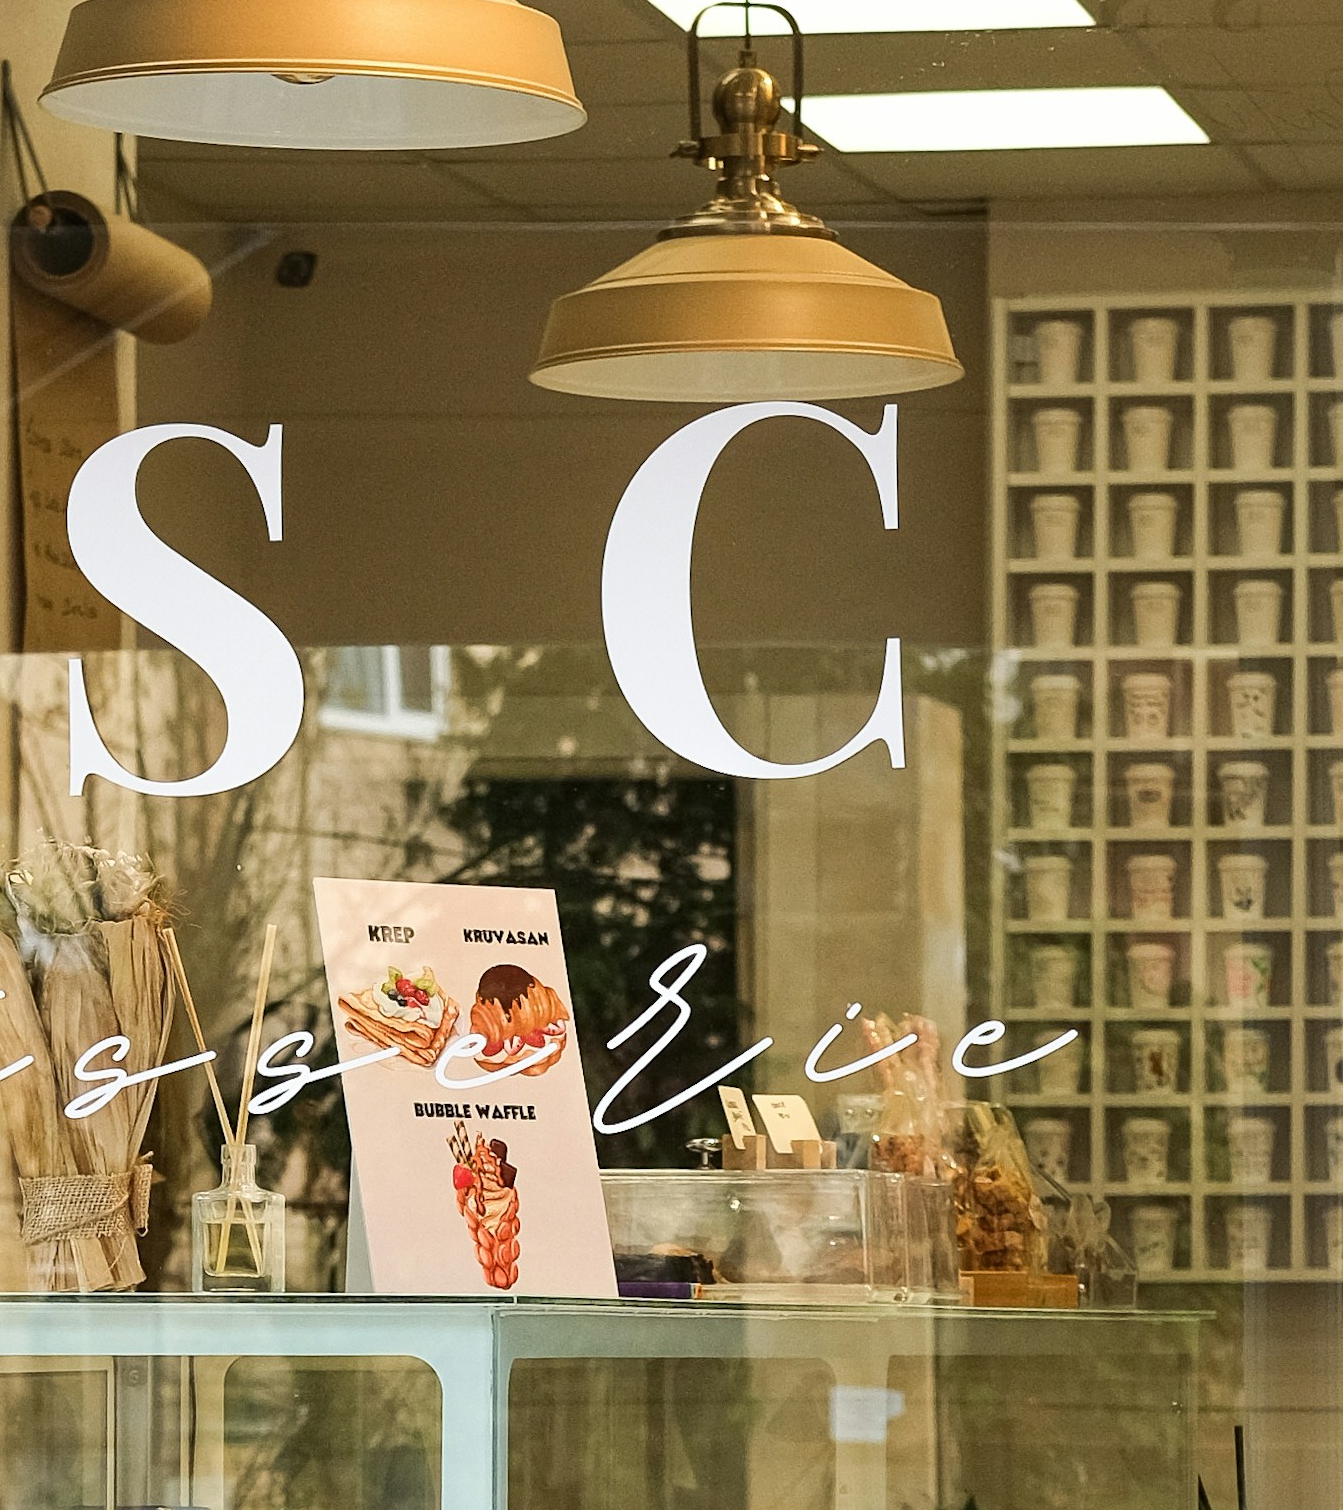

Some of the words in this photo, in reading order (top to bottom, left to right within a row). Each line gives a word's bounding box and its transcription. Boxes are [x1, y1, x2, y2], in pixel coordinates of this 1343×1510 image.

[367, 924, 416, 945] KREP
[463, 927, 550, 947] KRUVASAN
[414, 1101, 472, 1120] BUBBLE
[475, 1103, 537, 1122] WAFFLE
